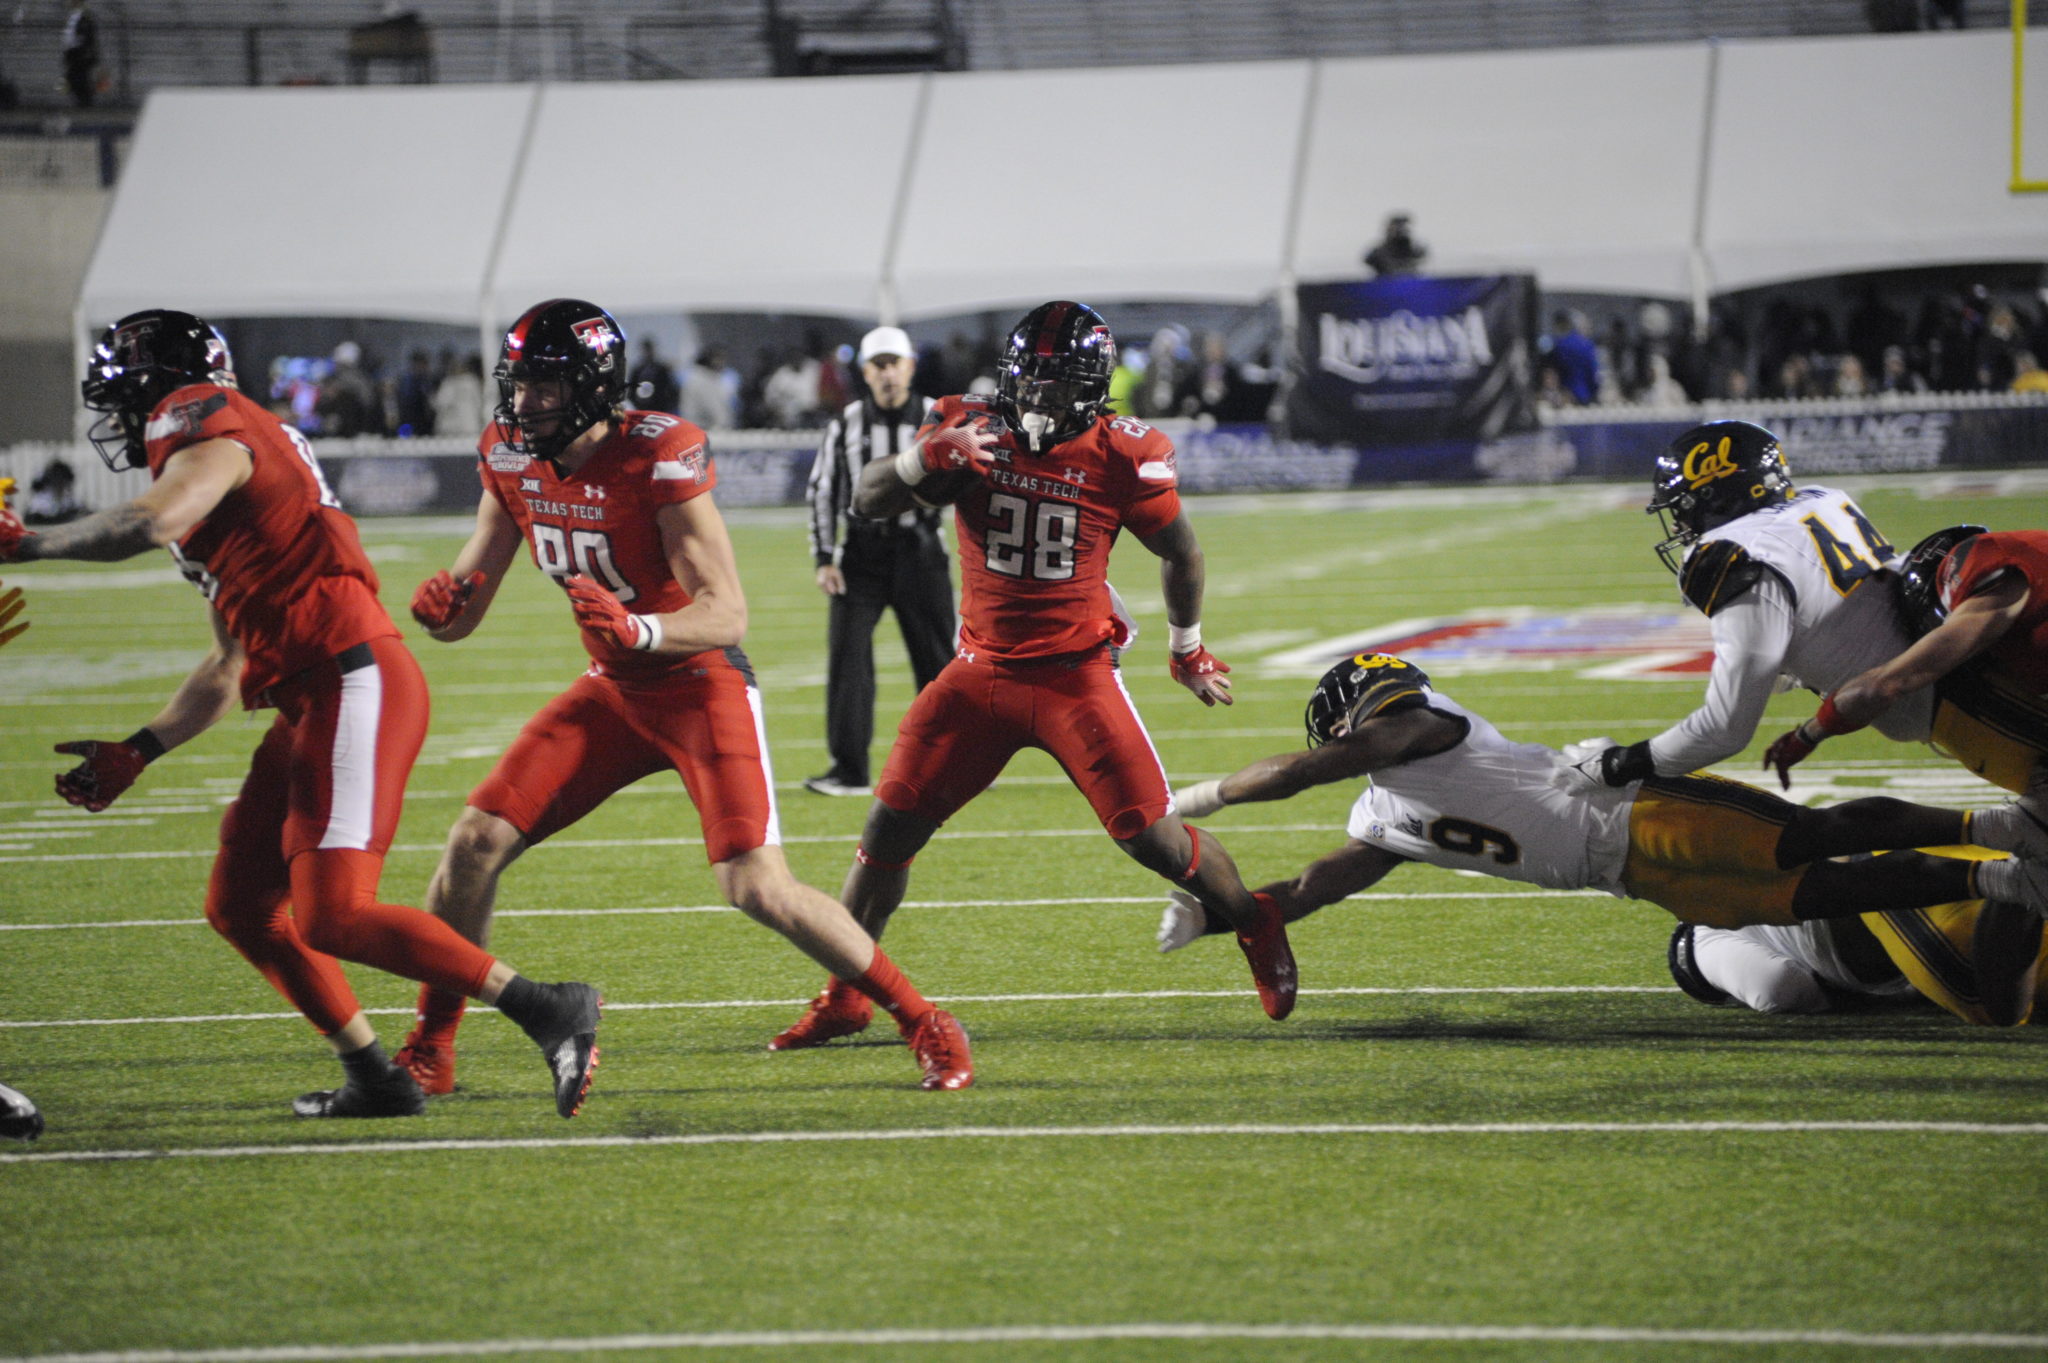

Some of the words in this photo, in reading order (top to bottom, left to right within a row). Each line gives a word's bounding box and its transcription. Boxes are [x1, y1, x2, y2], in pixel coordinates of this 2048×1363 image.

[992, 468, 1039, 492] TEXAS
[1043, 480, 1080, 499] TECH
[1683, 436, 1738, 490] Cal
[525, 498, 568, 517] TEXAS
[570, 503, 604, 521] TECH
[985, 492, 1078, 581] 28
[1799, 500, 1898, 598] 44
